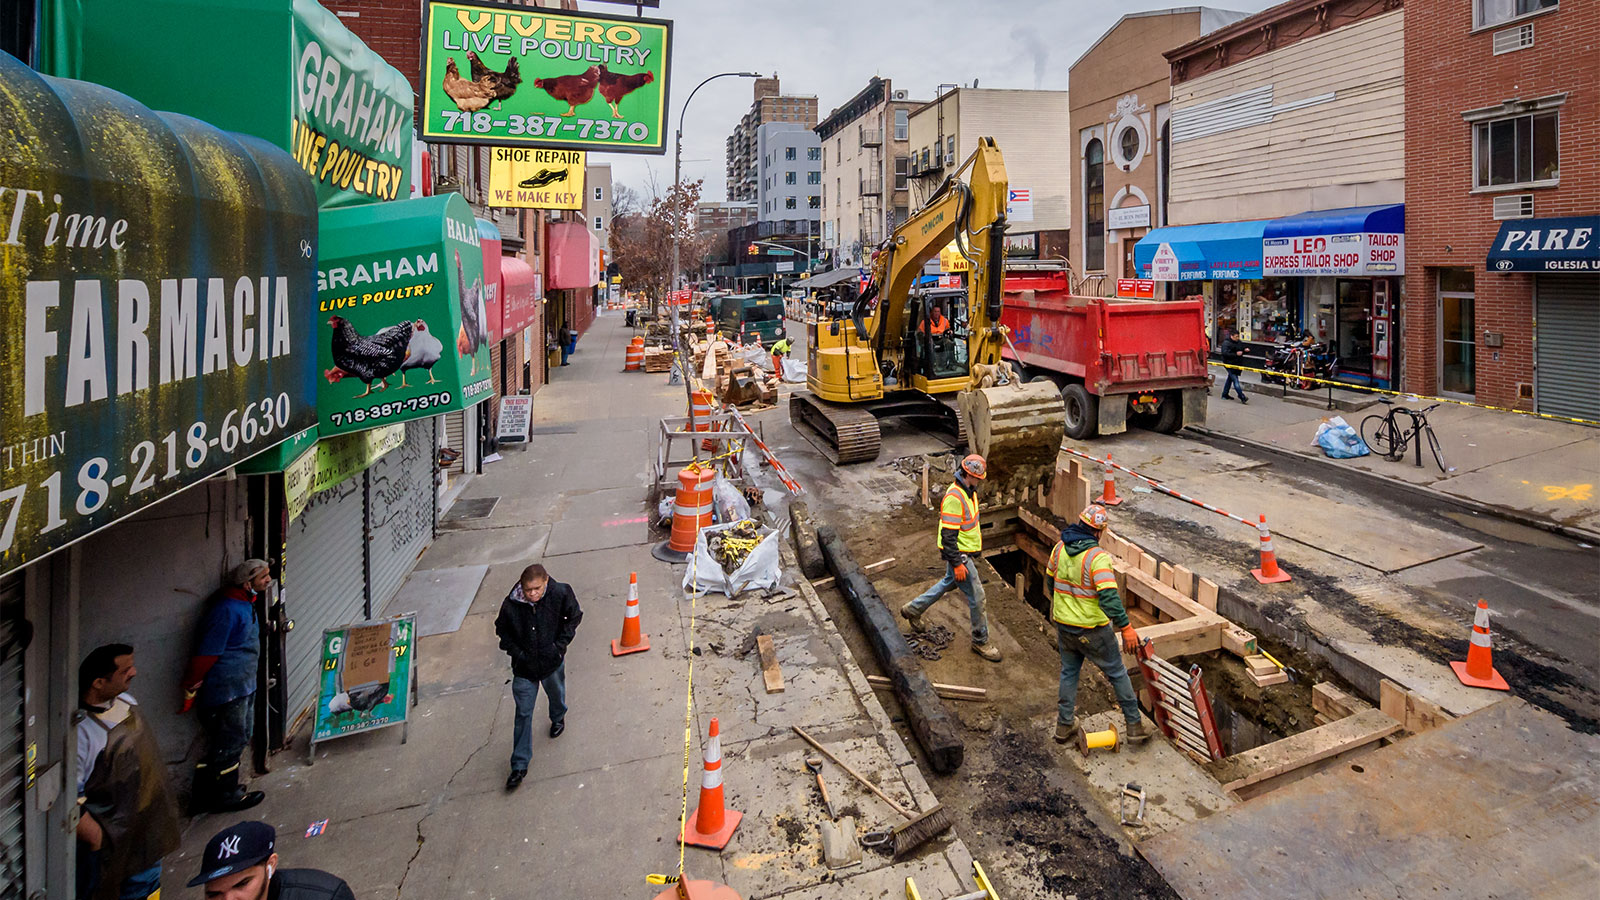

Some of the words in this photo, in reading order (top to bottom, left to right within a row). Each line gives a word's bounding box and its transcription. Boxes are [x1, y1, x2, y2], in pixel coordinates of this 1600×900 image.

[456, 10, 641, 47] VIVERO
[443, 30, 512, 54] LIVE
[521, 37, 651, 66] POULTRY
[300, 41, 405, 159] GRAHAM
[441, 110, 649, 142] 718-387-7370
[291, 117, 327, 177] LIVE
[320, 141, 403, 201] POULTRY
[496, 148, 531, 162] SHOE
[535, 150, 580, 165] REPAIR
[495, 189, 514, 202] WE
[516, 190, 552, 204] MAKE
[554, 191, 578, 206] KEY
[0, 187, 128, 250] Time
[446, 216, 480, 248] HALAL
[1293, 238, 1327, 254] LEO
[1368, 234, 1399, 246] TAILOR
[1500, 227, 1593, 251] PARE
[1264, 256, 1300, 268] EXPRESS
[1301, 254, 1331, 267] TAILOR
[1333, 253, 1359, 267] SHOP
[1370, 250, 1396, 262] SHOP
[1499, 261, 1509, 270] 97
[1545, 261, 1589, 270] IGLESIA
[317, 252, 439, 292] GRAHAM
[1180, 270, 1207, 280] PERFUMES
[1212, 269, 1240, 279] PERFUMES
[319, 295, 357, 312] LIVE
[362, 283, 434, 306] POULTRY
[24, 275, 290, 418] FARMACIA
[331, 391, 452, 428] 718-387-7370
[2, 430, 66, 471] THIN
[0, 392, 291, 552] 718-218-6630
[217, 834, 241, 860] NY
